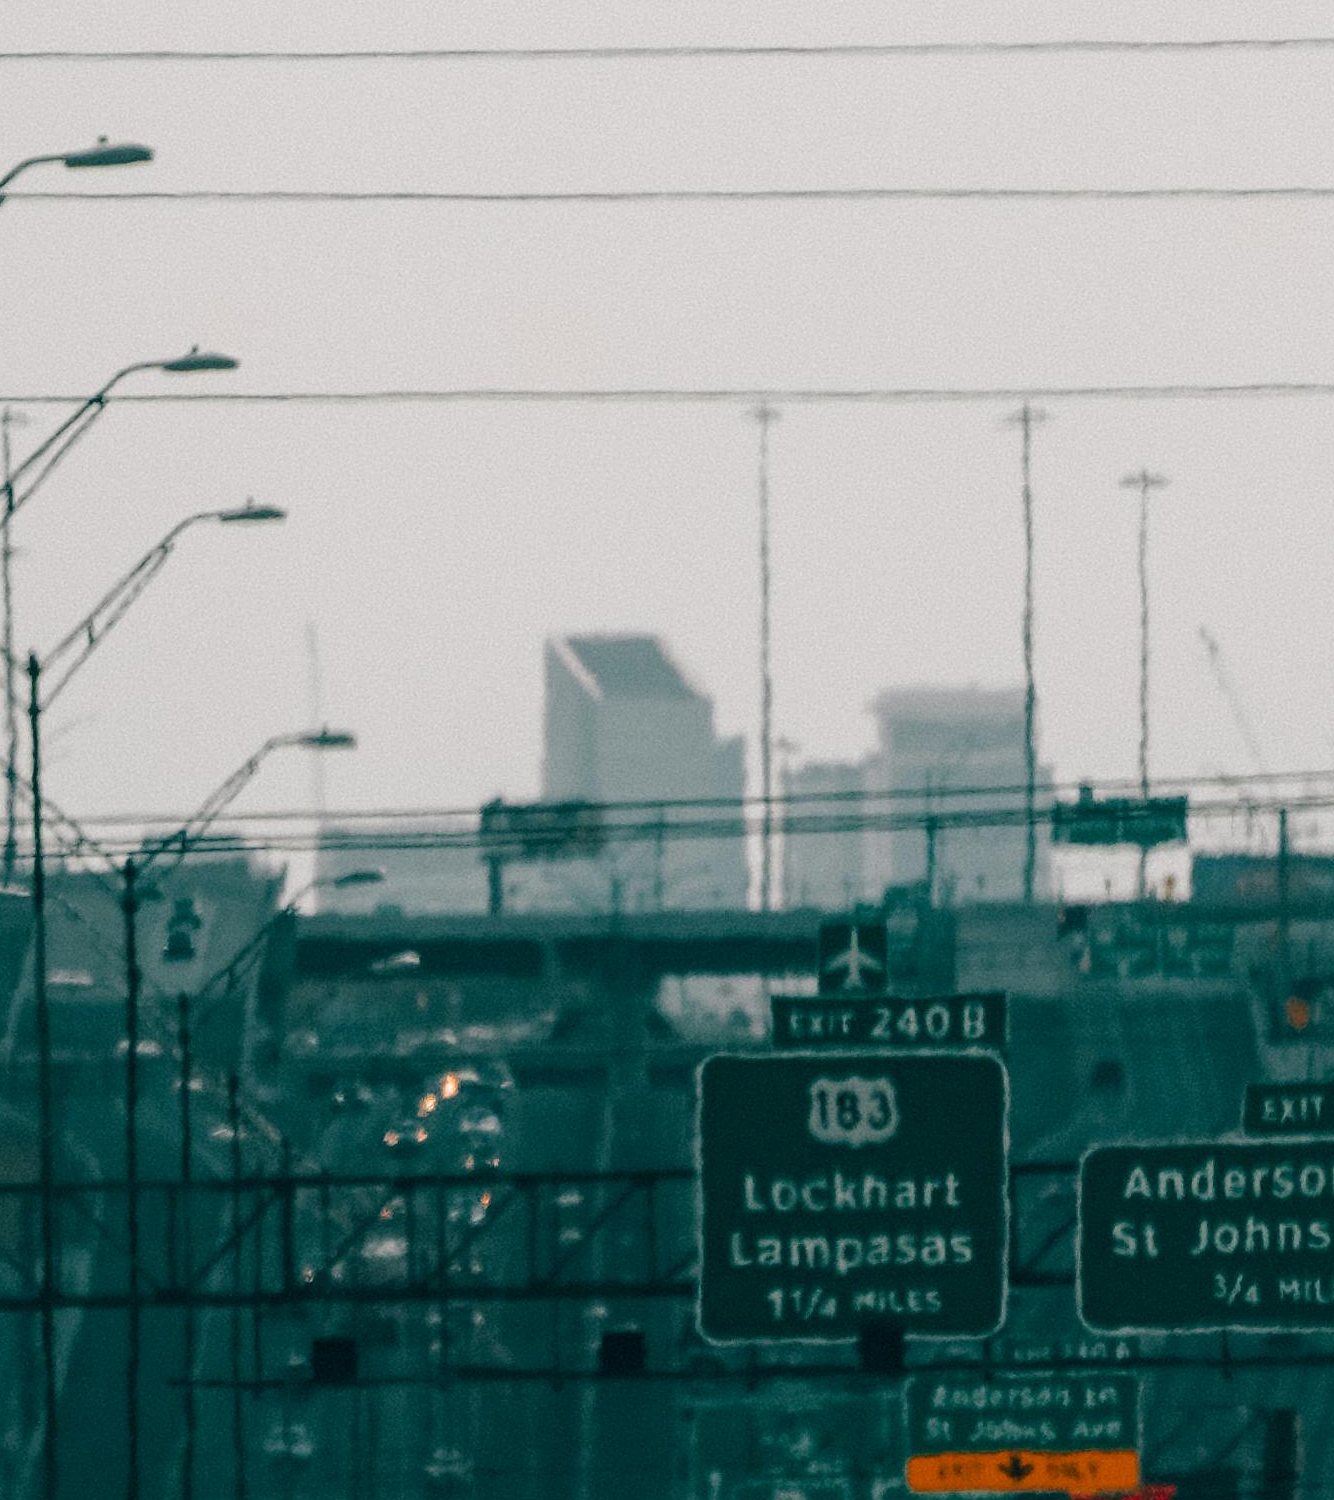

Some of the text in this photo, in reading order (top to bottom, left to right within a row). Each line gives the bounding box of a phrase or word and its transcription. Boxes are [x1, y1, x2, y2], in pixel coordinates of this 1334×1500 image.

[790, 1012, 853, 1034] EXIT
[870, 1006, 951, 1038] 240
[818, 1089, 892, 1132] 183
[1263, 1096, 1324, 1123] EXIT
[743, 1171, 961, 1212] Lockhart
[731, 1232, 973, 1276] Lampasas
[1112, 1221, 1159, 1257] St
[1191, 1215, 1331, 1256] Johns
[853, 1289, 943, 1313] MILES
